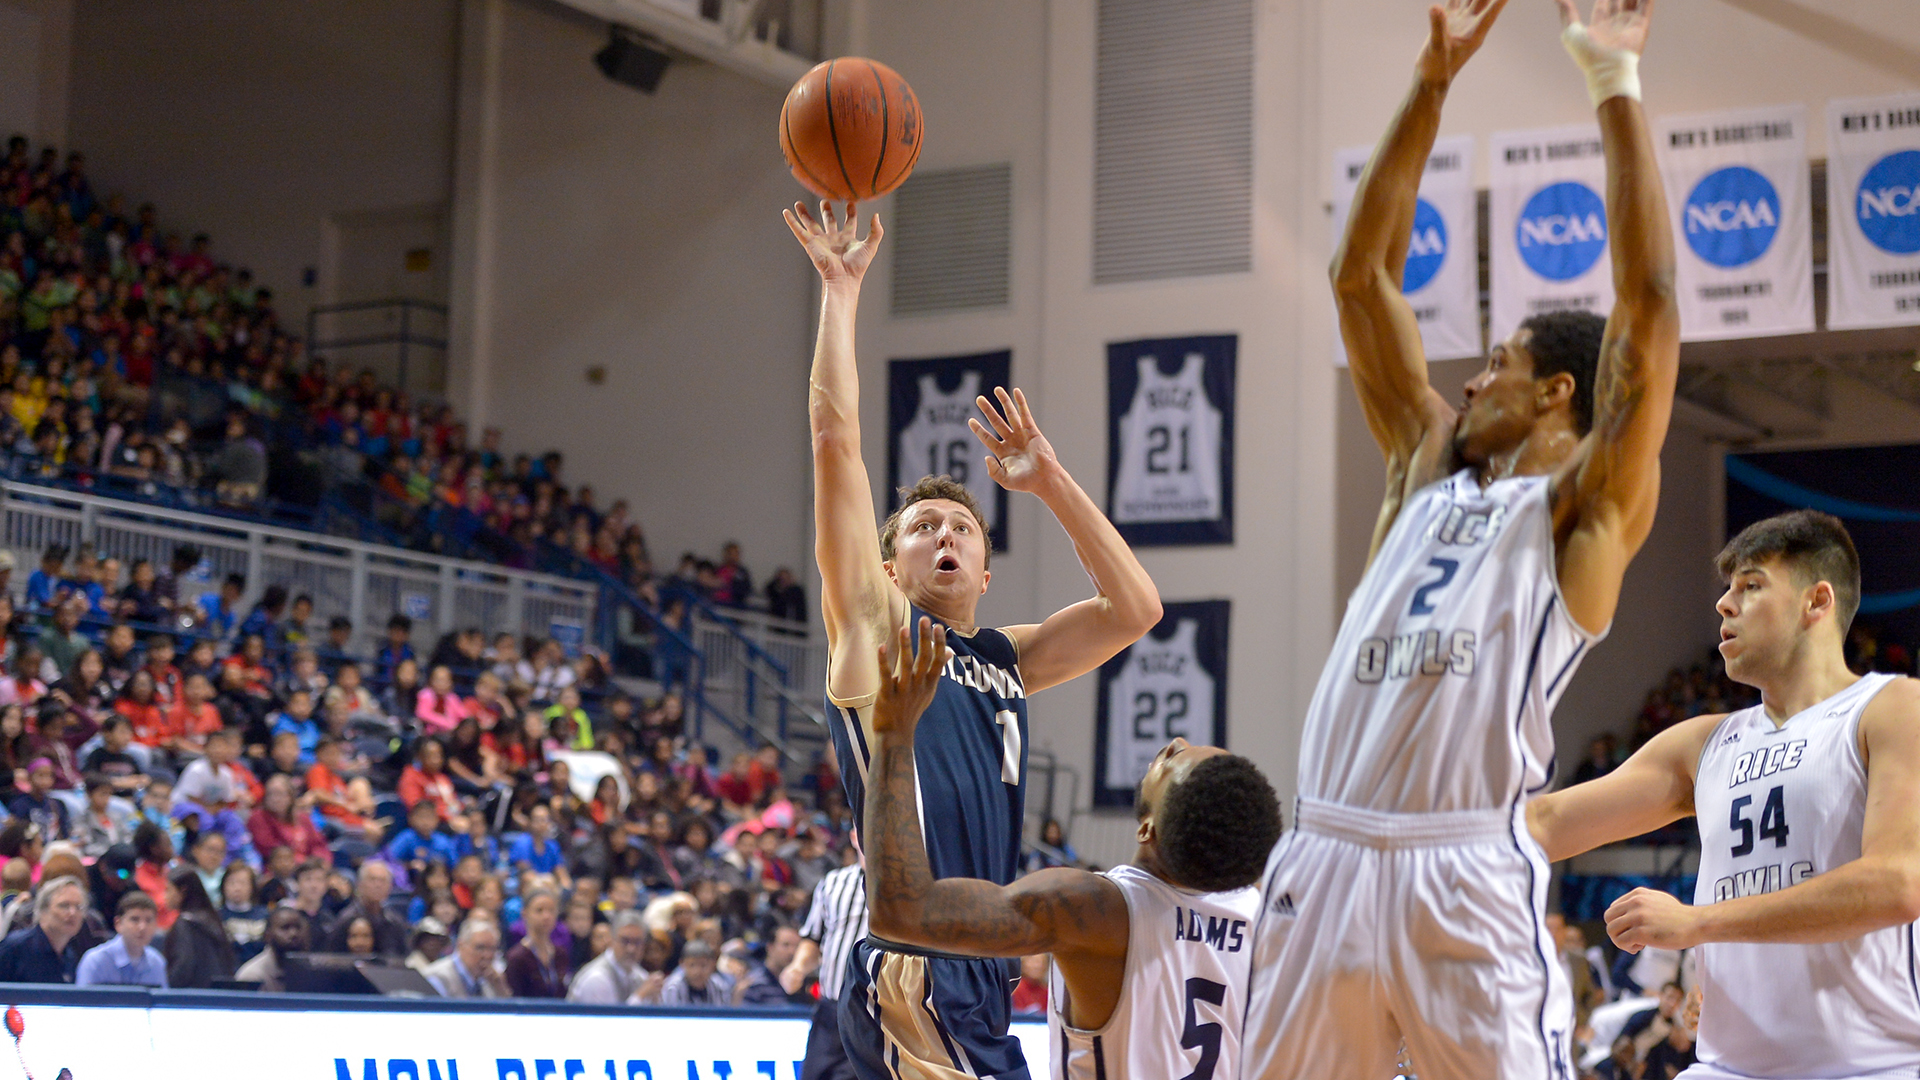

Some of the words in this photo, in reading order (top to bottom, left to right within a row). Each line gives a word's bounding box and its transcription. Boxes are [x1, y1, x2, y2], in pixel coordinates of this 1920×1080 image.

[1520, 211, 1606, 248] NCAA
[1687, 198, 1776, 234] NCAA
[929, 440, 969, 483] 16
[1146, 425, 1191, 474] 21
[1408, 557, 1459, 617] 2
[1355, 629, 1476, 684] OWLS
[1134, 691, 1188, 740] 22
[995, 709, 1021, 786] 1
[1729, 739, 1807, 789] RICE
[1729, 785, 1789, 858] 54
[1180, 977, 1227, 1080] 5
